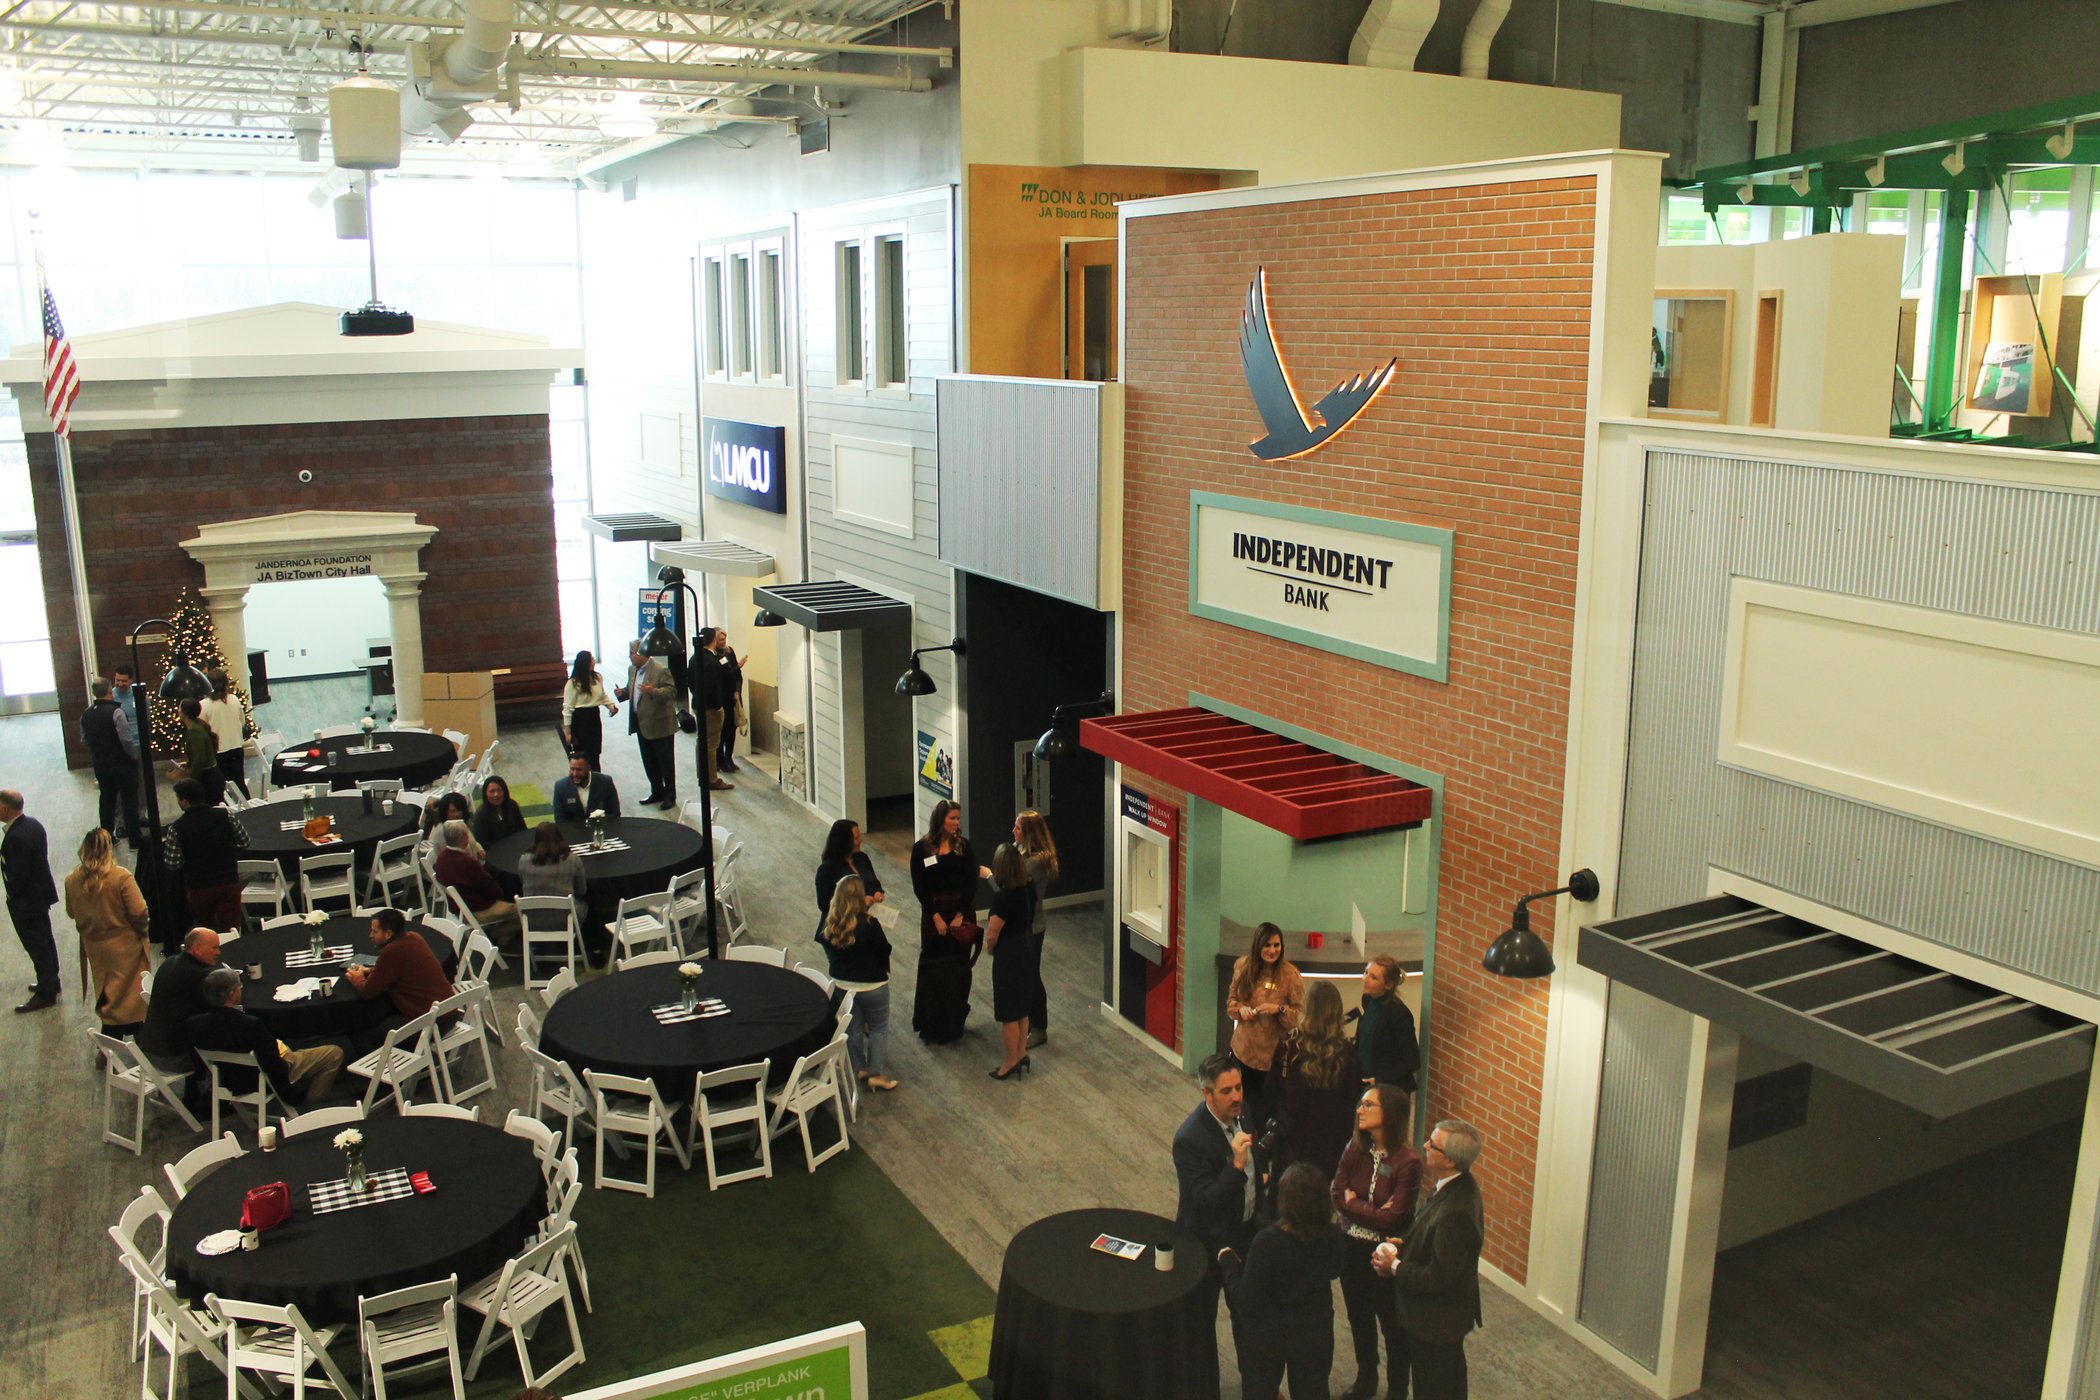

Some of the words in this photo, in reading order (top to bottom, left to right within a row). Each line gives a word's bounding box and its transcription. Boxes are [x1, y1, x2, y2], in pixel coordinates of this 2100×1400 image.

[1039, 189, 1072, 204] DON
[1076, 191, 1086, 205] &
[1038, 207, 1053, 218] JA
[1056, 207, 1087, 219] Board
[723, 442, 770, 493] LMCU
[255, 559, 312, 570] JANDERNOA
[313, 555, 372, 566] FOUNDATION
[1233, 532, 1393, 589] INDEPENDENT
[257, 571, 273, 582] JA
[275, 569, 323, 581] BizTown
[325, 567, 348, 577] City
[350, 565, 371, 575] Hall
[645, 592, 668, 600] meier
[1284, 584, 1330, 612] BANK
[1125, 793, 1154, 812] INDEPENDENT
[1128, 805, 1141, 817] WALK
[1147, 815, 1167, 828] WINDOW
[722, 1366, 812, 1400] VERPLANK
